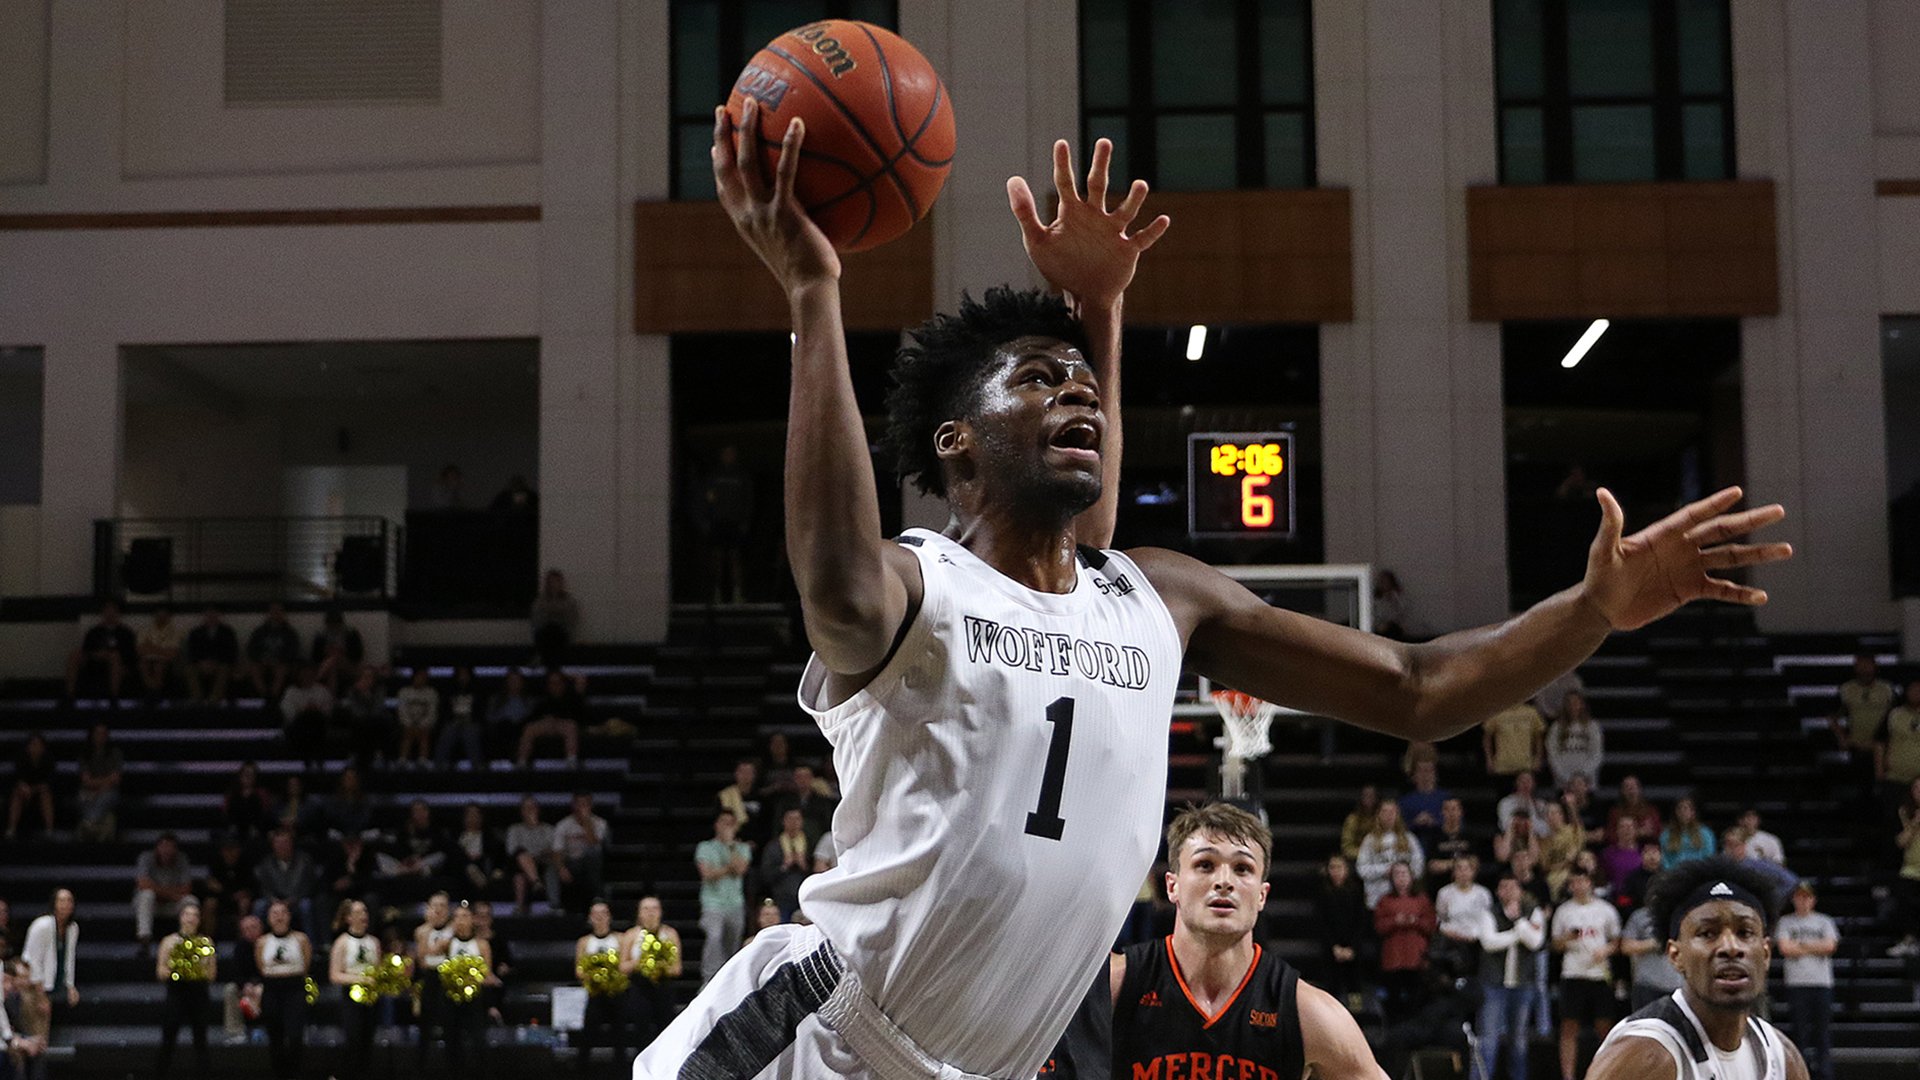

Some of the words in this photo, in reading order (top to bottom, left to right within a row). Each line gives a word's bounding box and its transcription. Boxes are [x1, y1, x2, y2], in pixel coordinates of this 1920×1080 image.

[788, 22, 858, 80] lson
[736, 64, 790, 112] CAA
[1210, 443, 1284, 476] 12:06
[1241, 474, 1275, 528] 6
[963, 615, 1151, 690] WOFFORD
[1023, 696, 1075, 842] 1
